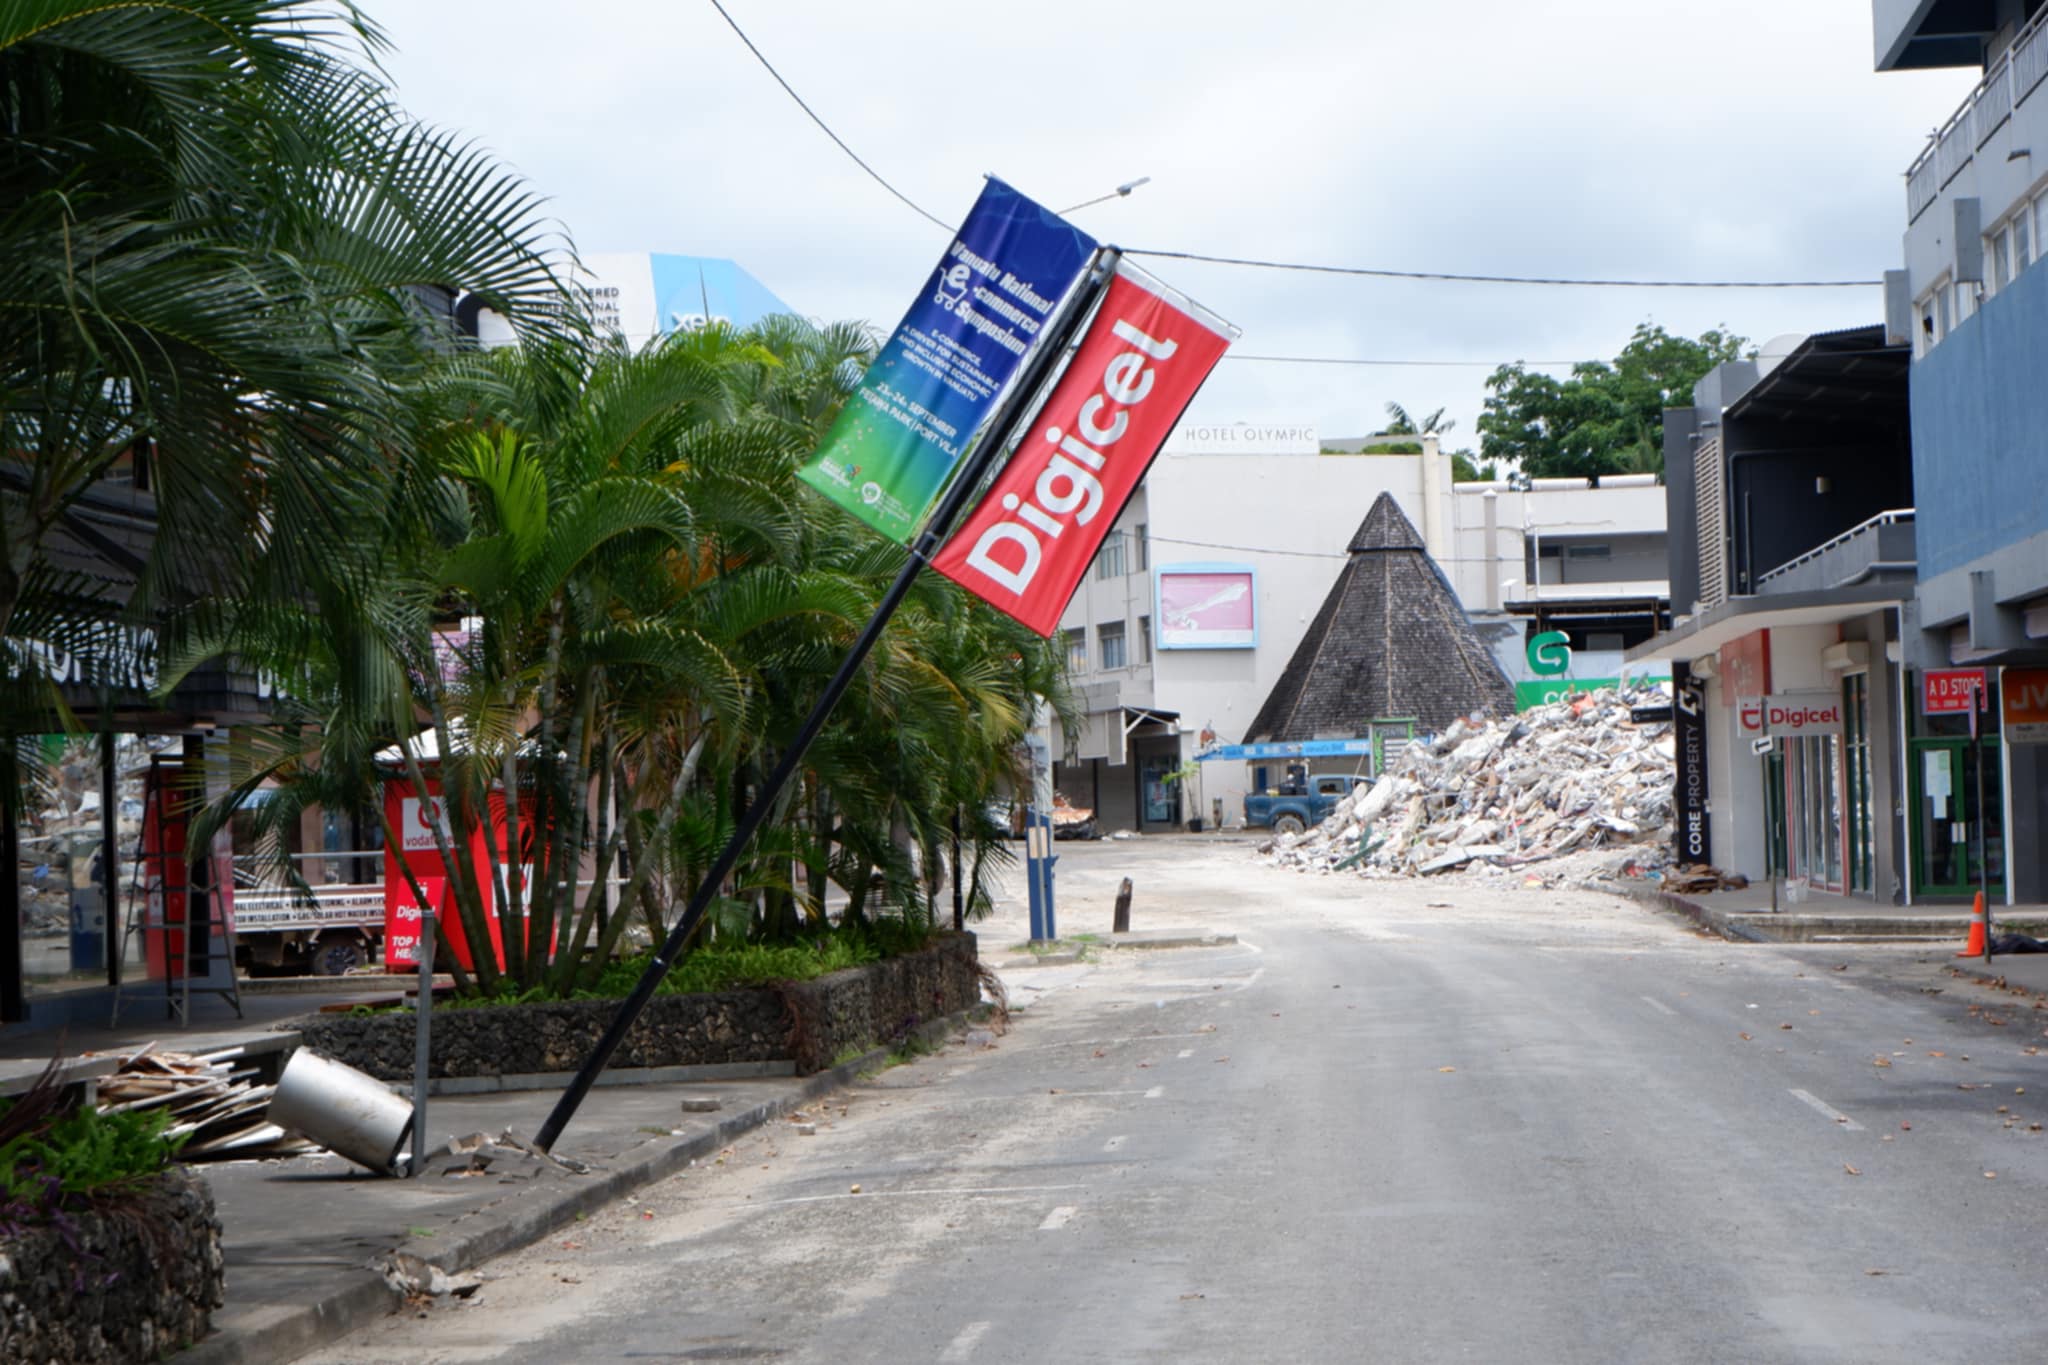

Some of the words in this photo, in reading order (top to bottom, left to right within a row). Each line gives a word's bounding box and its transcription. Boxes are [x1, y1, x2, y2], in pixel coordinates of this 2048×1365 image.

[952, 241, 1000, 280] Vanuatu
[999, 273, 1055, 314] National
[954, 300, 1027, 356] Symposium
[899, 335, 916, 348] AND
[915, 344, 950, 370] INCLUSIVE
[951, 368, 991, 397] ECONOMIC
[903, 350, 936, 374] GROWTH
[944, 376, 977, 401] VANUATU
[936, 345, 951, 358] FOR
[952, 355, 1000, 390] SUSTAINABLE
[889, 407, 913, 426] PARK
[914, 423, 939, 442] PORT
[939, 439, 957, 457] VILA
[908, 402, 956, 437] SEPTEMBER
[1185, 428, 1237, 441] HOTEL
[1244, 428, 1314, 441] OLYMPIC
[966, 319, 1178, 596] Digicel
[1929, 679, 1937, 696] A
[1940, 679, 1948, 696] D
[1769, 706, 1840, 728] Digicel
[1686, 725, 1700, 807] PROPERTY
[1689, 811, 1702, 856] CORE
[396, 905, 435, 921] Digil
[392, 936, 413, 946] TOP
